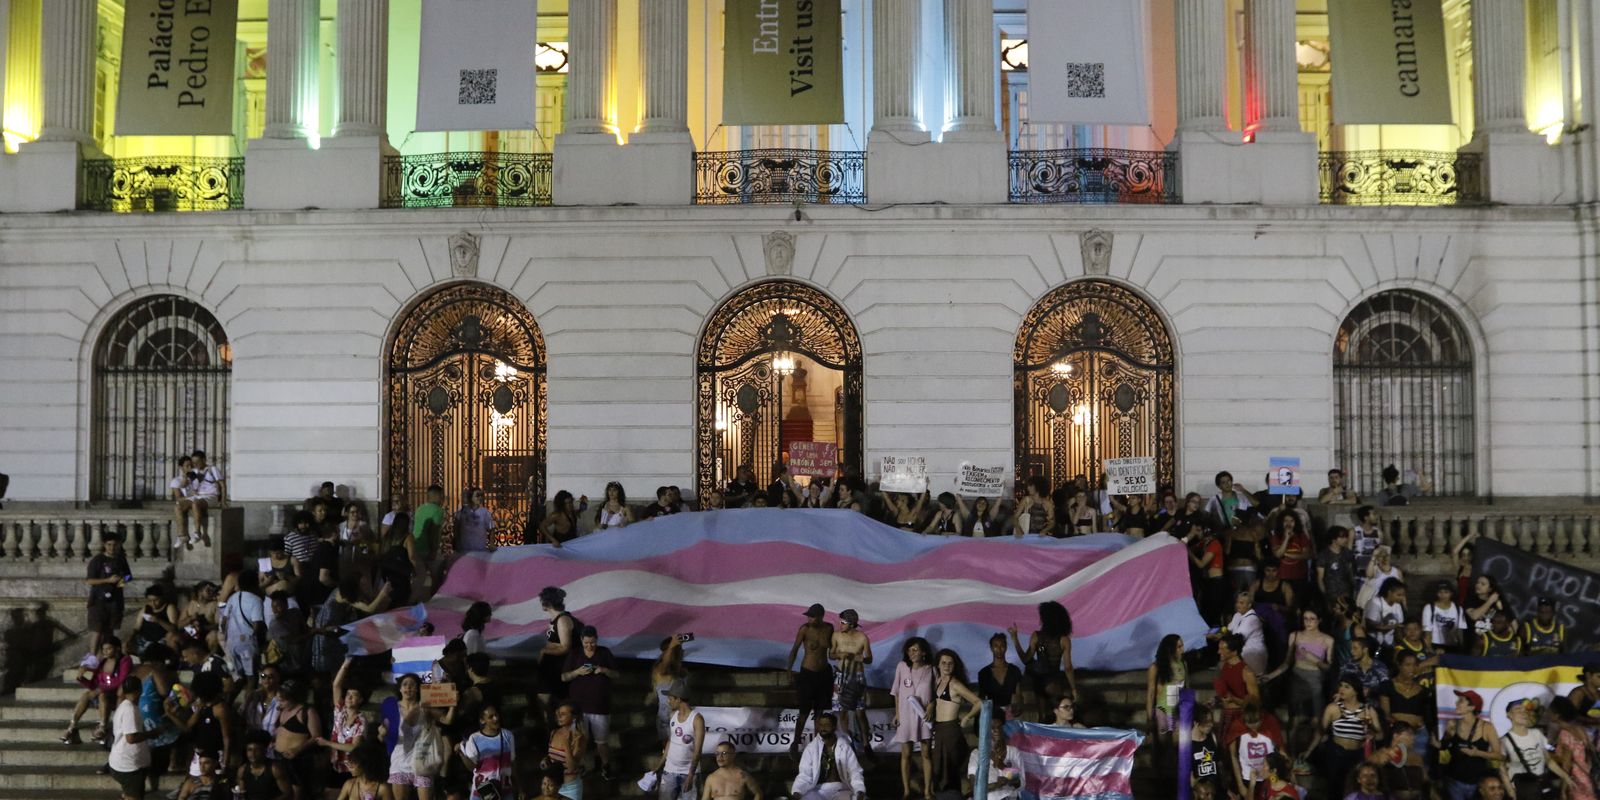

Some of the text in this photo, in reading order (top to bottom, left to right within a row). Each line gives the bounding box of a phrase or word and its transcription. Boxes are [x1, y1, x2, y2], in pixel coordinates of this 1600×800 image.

[147, 0, 175, 89] Palácio
[177, 26, 210, 108] Pedro
[789, 0, 813, 97] Visit us
[1124, 475, 1147, 485] SEXO
[1528, 562, 1600, 606] PROL
[727, 732, 791, 746] NOVOS
